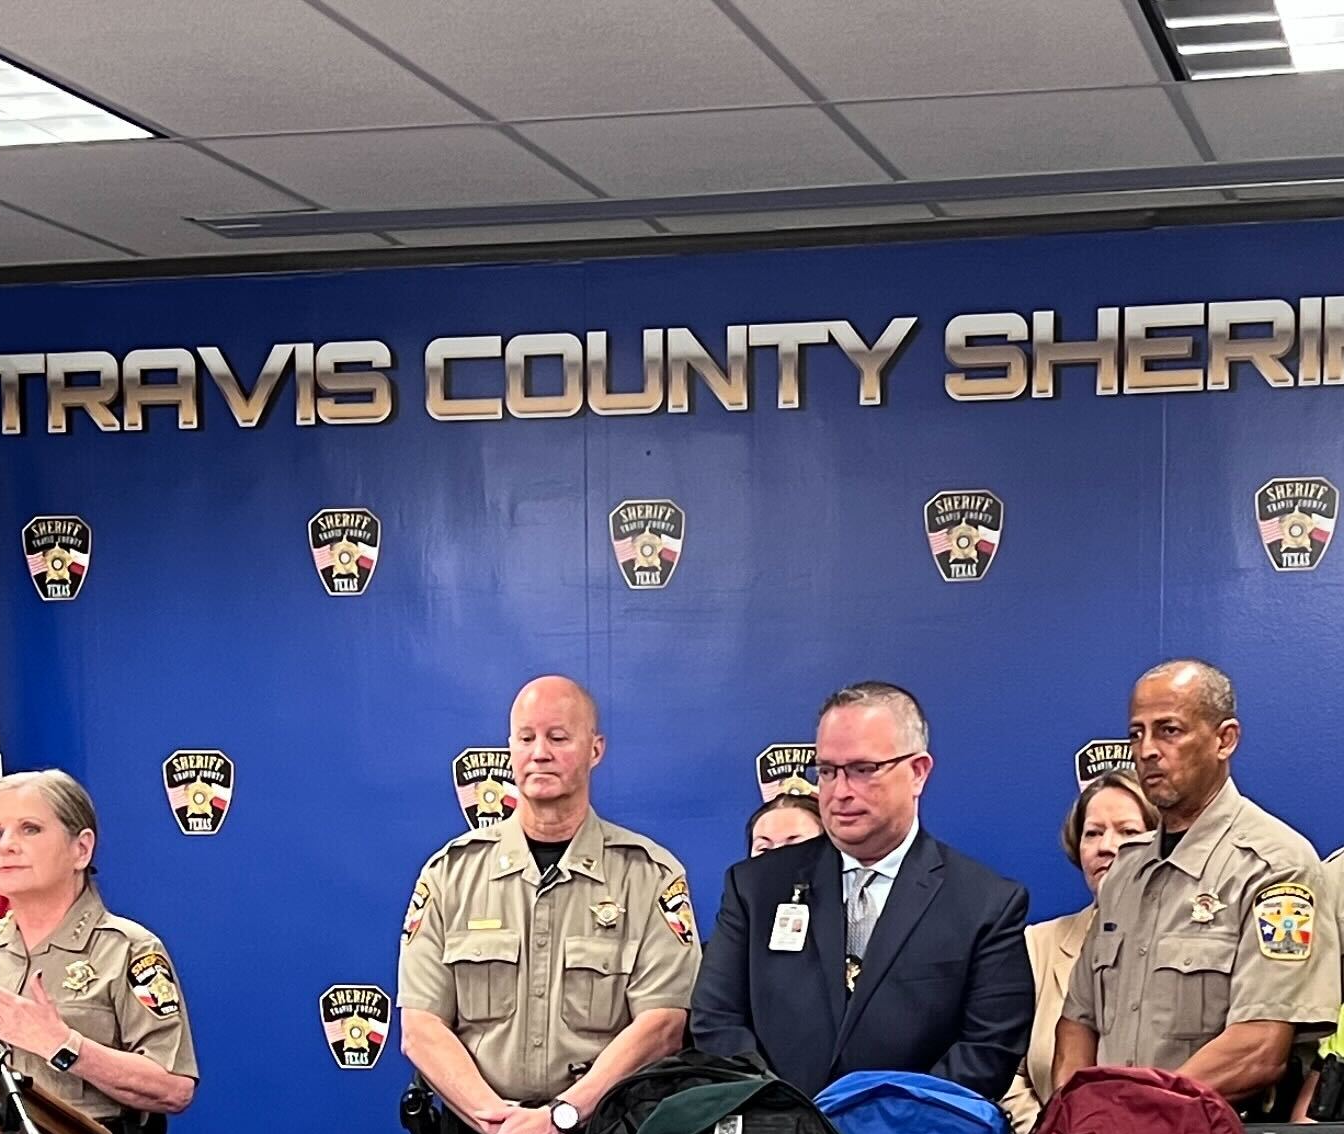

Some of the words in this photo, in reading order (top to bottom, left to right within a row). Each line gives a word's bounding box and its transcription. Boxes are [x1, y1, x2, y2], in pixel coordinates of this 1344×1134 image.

[425, 315, 917, 421] COUNTY
[1266, 482, 1328, 501] SHERIFF
[936, 496, 993, 514] SHERIFF
[318, 513, 371, 530] SHERIFF
[620, 505, 675, 523] SHERIFF
[31, 521, 82, 537] SHERIFF
[1281, 552, 1310, 567] TEXAS
[635, 572, 661, 585] TEXAS
[950, 563, 977, 578] TEXAS
[47, 584, 71, 597] TEXAS
[333, 578, 358, 592] TEXAS
[172, 755, 225, 771] SHERIFF
[766, 749, 815, 766] SHERIF
[188, 817, 212, 831] TEXAS
[329, 989, 382, 1006] SHERIFF
[344, 1051, 368, 1065] TEXAS
